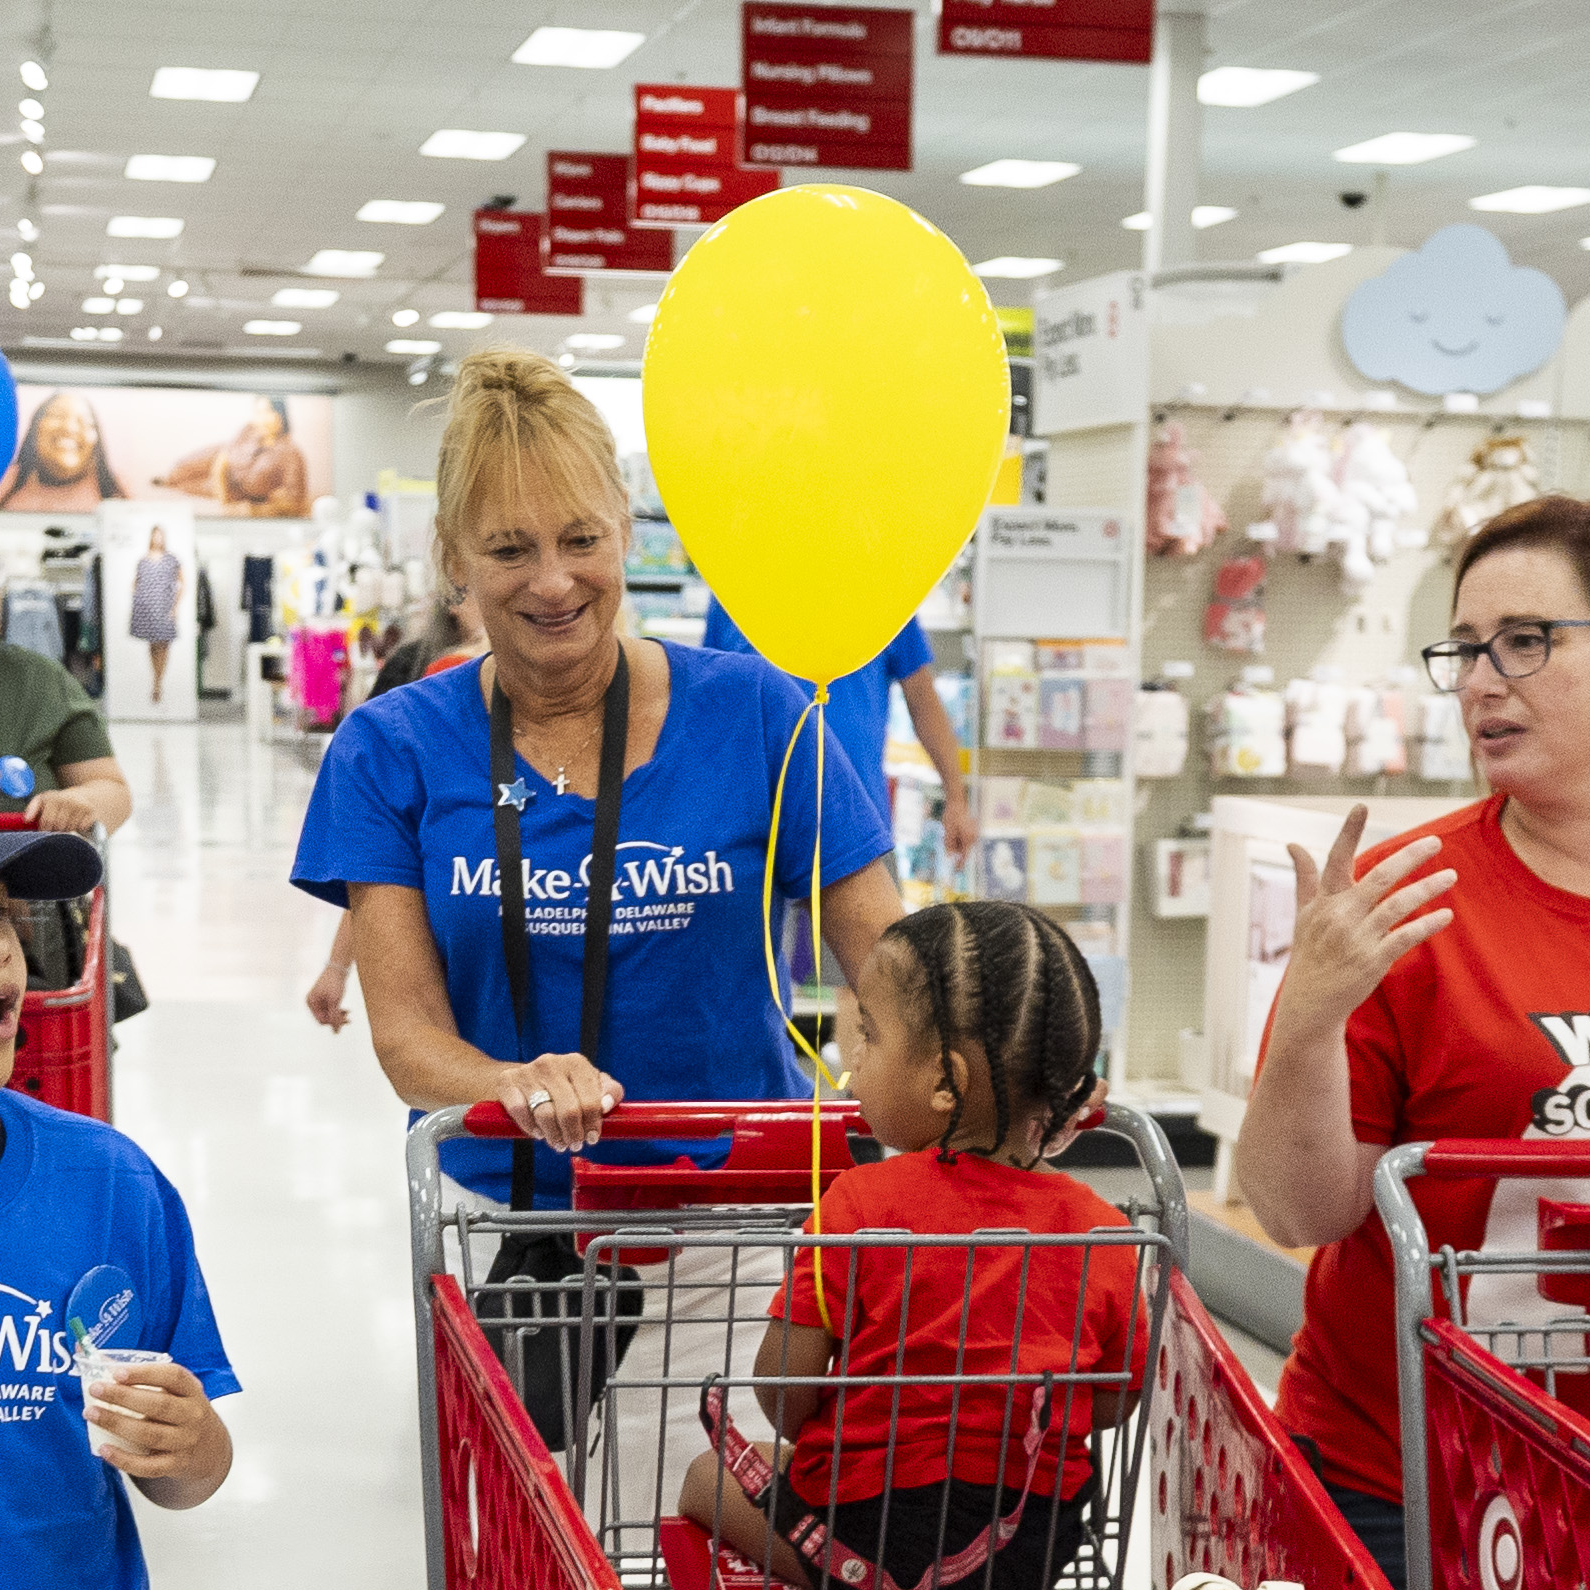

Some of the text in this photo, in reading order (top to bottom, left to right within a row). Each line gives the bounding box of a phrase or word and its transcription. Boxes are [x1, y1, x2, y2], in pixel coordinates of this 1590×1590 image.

[450, 848, 735, 902] Make--Wish
[615, 902, 696, 919] DELAWARE
[637, 916, 691, 933] VALLEY
